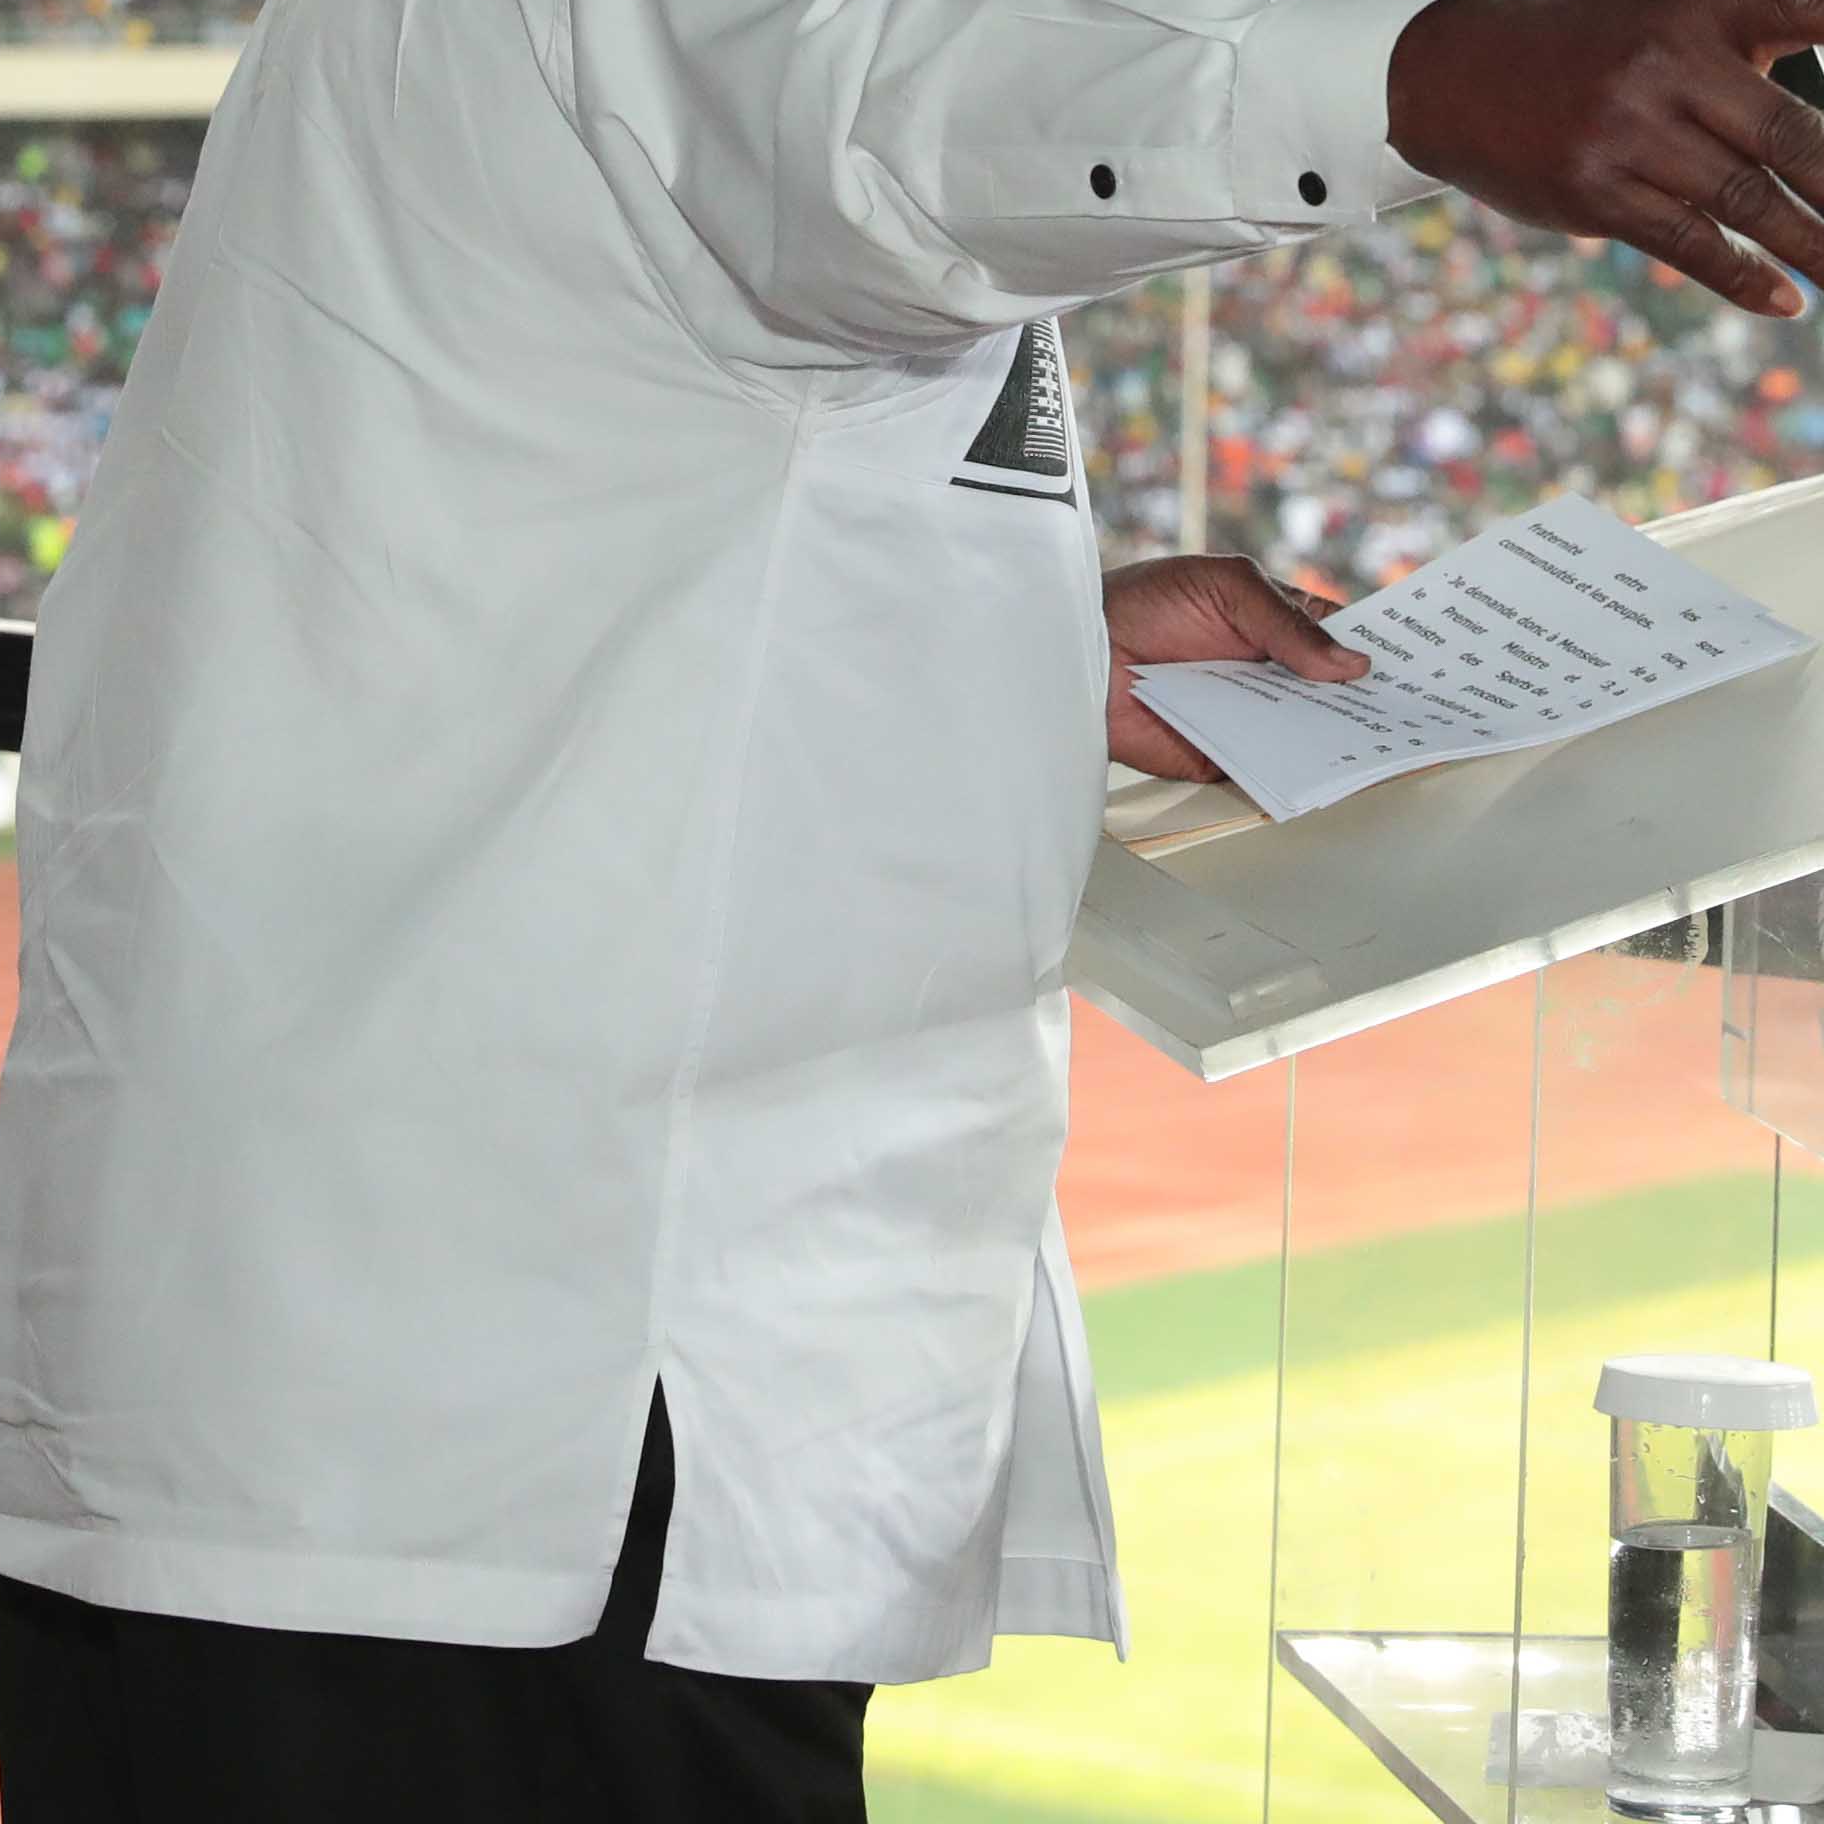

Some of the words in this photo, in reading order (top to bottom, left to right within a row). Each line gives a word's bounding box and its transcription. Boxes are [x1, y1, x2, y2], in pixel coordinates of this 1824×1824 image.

[1498, 538, 1578, 585] communautés
[1576, 582, 1592, 593] et
[1589, 587, 1610, 603] les
[1602, 598, 1655, 630] peuples.
[1528, 522, 1588, 556] fraternité
[1613, 572, 1649, 593] entre
[1679, 608, 1702, 624] les
[1349, 624, 1415, 663] poursuivre
[1430, 668, 1447, 679] le
[1382, 607, 1402, 621] au
[1398, 615, 1447, 647] Ministre
[1458, 652, 1483, 666] des
[1495, 670, 1534, 690] Sports
[1530, 686, 1550, 697] de
[1411, 587, 1427, 601] le
[1441, 605, 1489, 636] Premier
[1501, 641, 1550, 671] Ministre
[1563, 674, 1583, 684] et
[1447, 575, 1466, 589] Je
[1465, 585, 1518, 620] demande
[1516, 616, 1548, 637] donc
[1546, 632, 1561, 642] à
[1556, 637, 1611, 669] Monsieur
